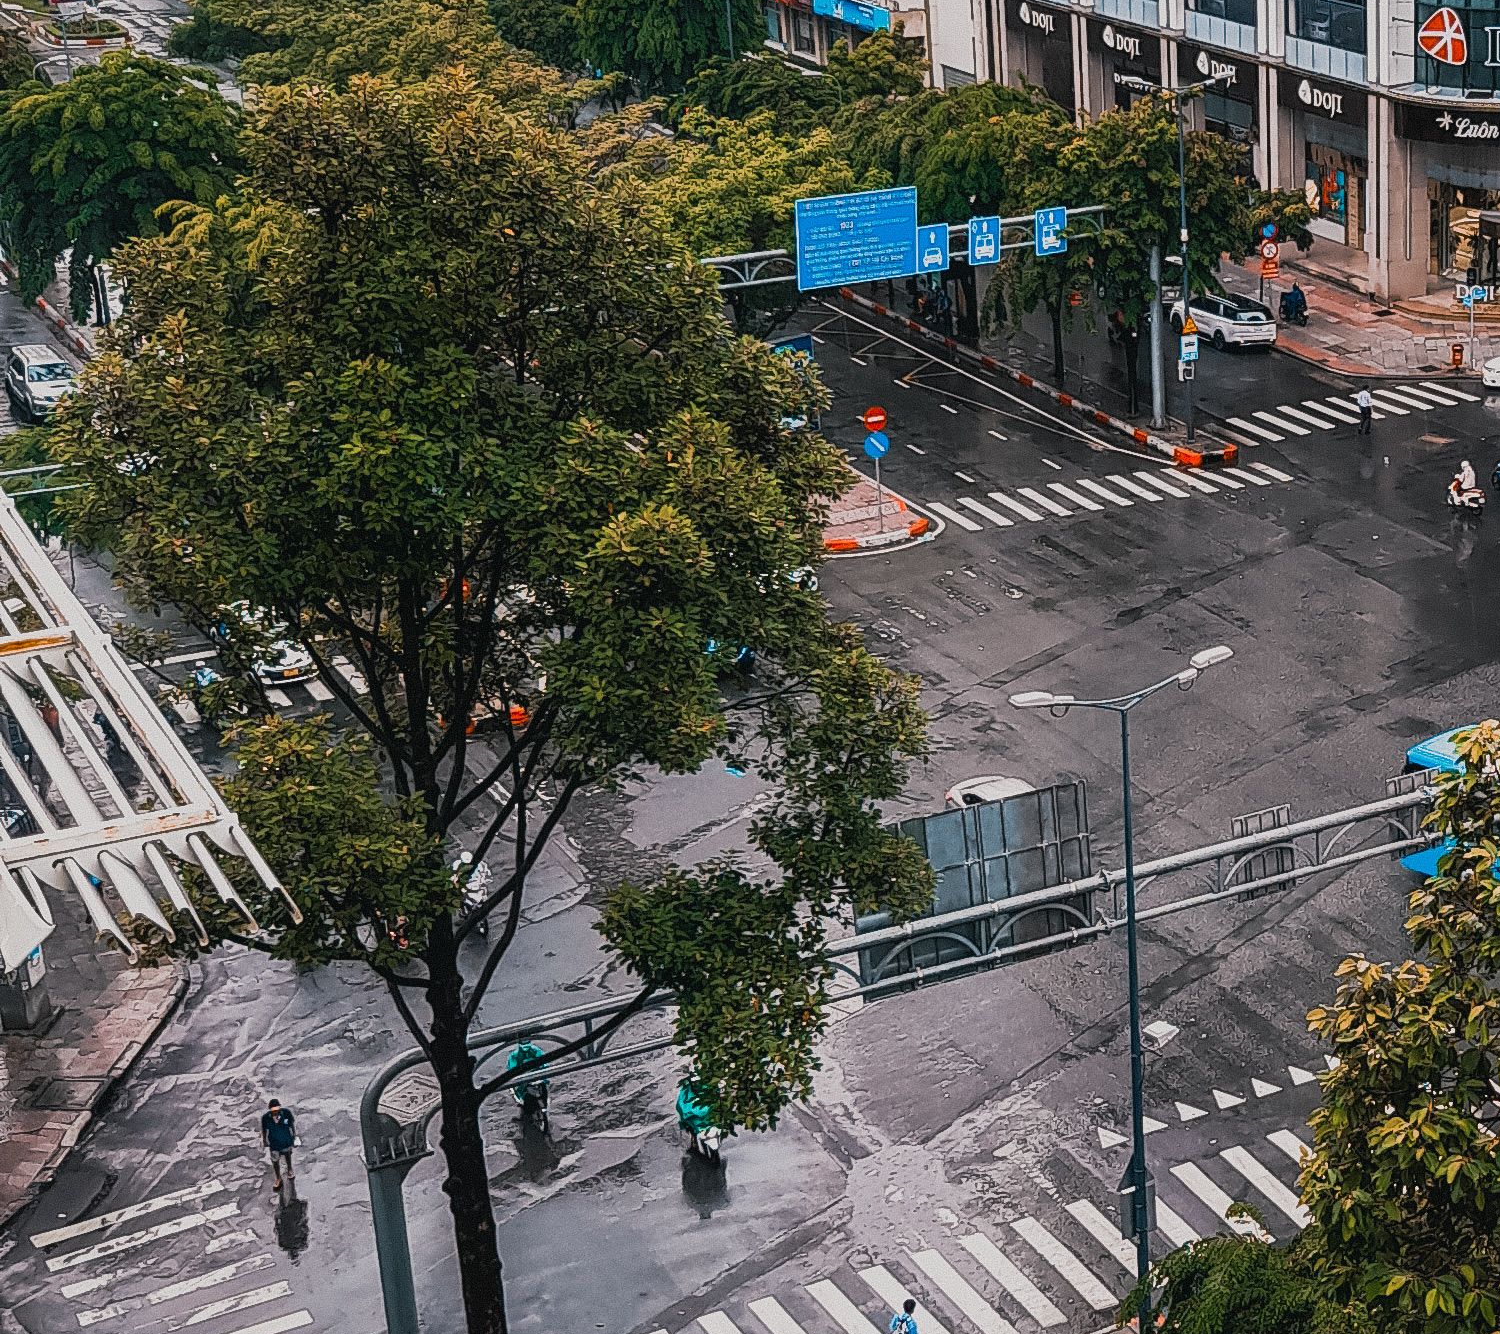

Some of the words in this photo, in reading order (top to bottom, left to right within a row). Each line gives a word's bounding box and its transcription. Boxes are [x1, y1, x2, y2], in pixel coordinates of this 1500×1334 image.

[1032, 10, 1056, 35] DOJI
[1116, 33, 1142, 60] DOJI
[1312, 88, 1343, 118] DOJI
[1453, 117, 1500, 140] Luôn
